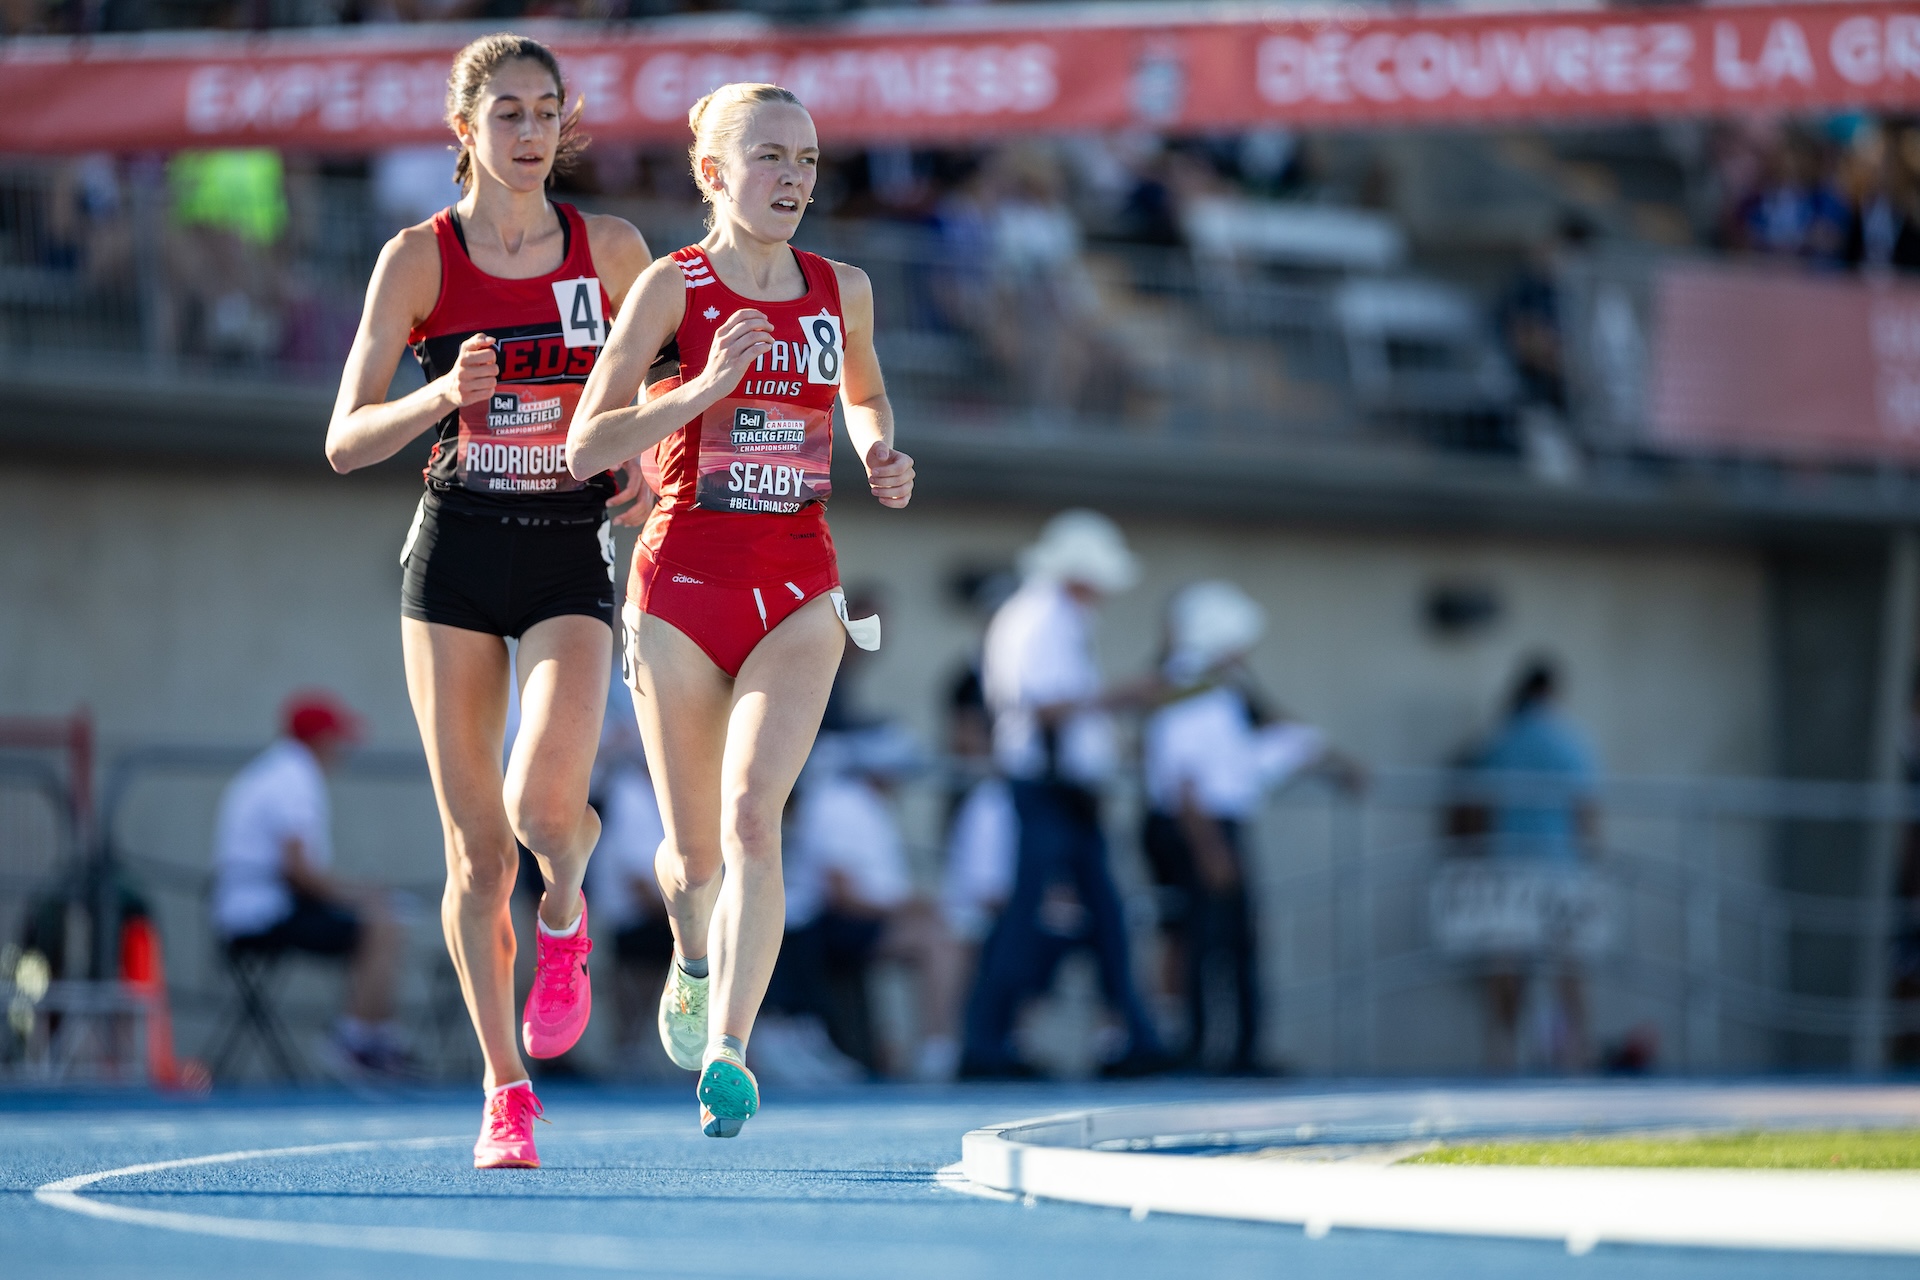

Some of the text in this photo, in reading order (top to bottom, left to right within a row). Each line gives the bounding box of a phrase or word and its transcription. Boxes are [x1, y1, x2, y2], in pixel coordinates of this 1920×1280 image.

[1713, 17, 1816, 89] LA
[570, 283, 598, 341] 4
[812, 319, 838, 381] 8
[501, 337, 596, 380] EDS
[745, 380, 802, 396] LIONS
[494, 397, 513, 410] Bell
[520, 400, 558, 411] CANADIAN
[489, 408, 561, 426] TRACK&FIELD
[740, 413, 760, 427] Bell
[766, 421, 803, 429] CANADIAN
[496, 423, 552, 435] CHAMPIONSHIPS
[732, 430, 804, 443] TRACK&FIELD
[740, 444, 797, 452] CHAMPIONSHIPS
[466, 442, 567, 475] RODRIGUE
[489, 478, 557, 491] #BELLTRIALS23
[728, 461, 805, 497] SEABY
[729, 497, 800, 513] #BELLTRIALS23
